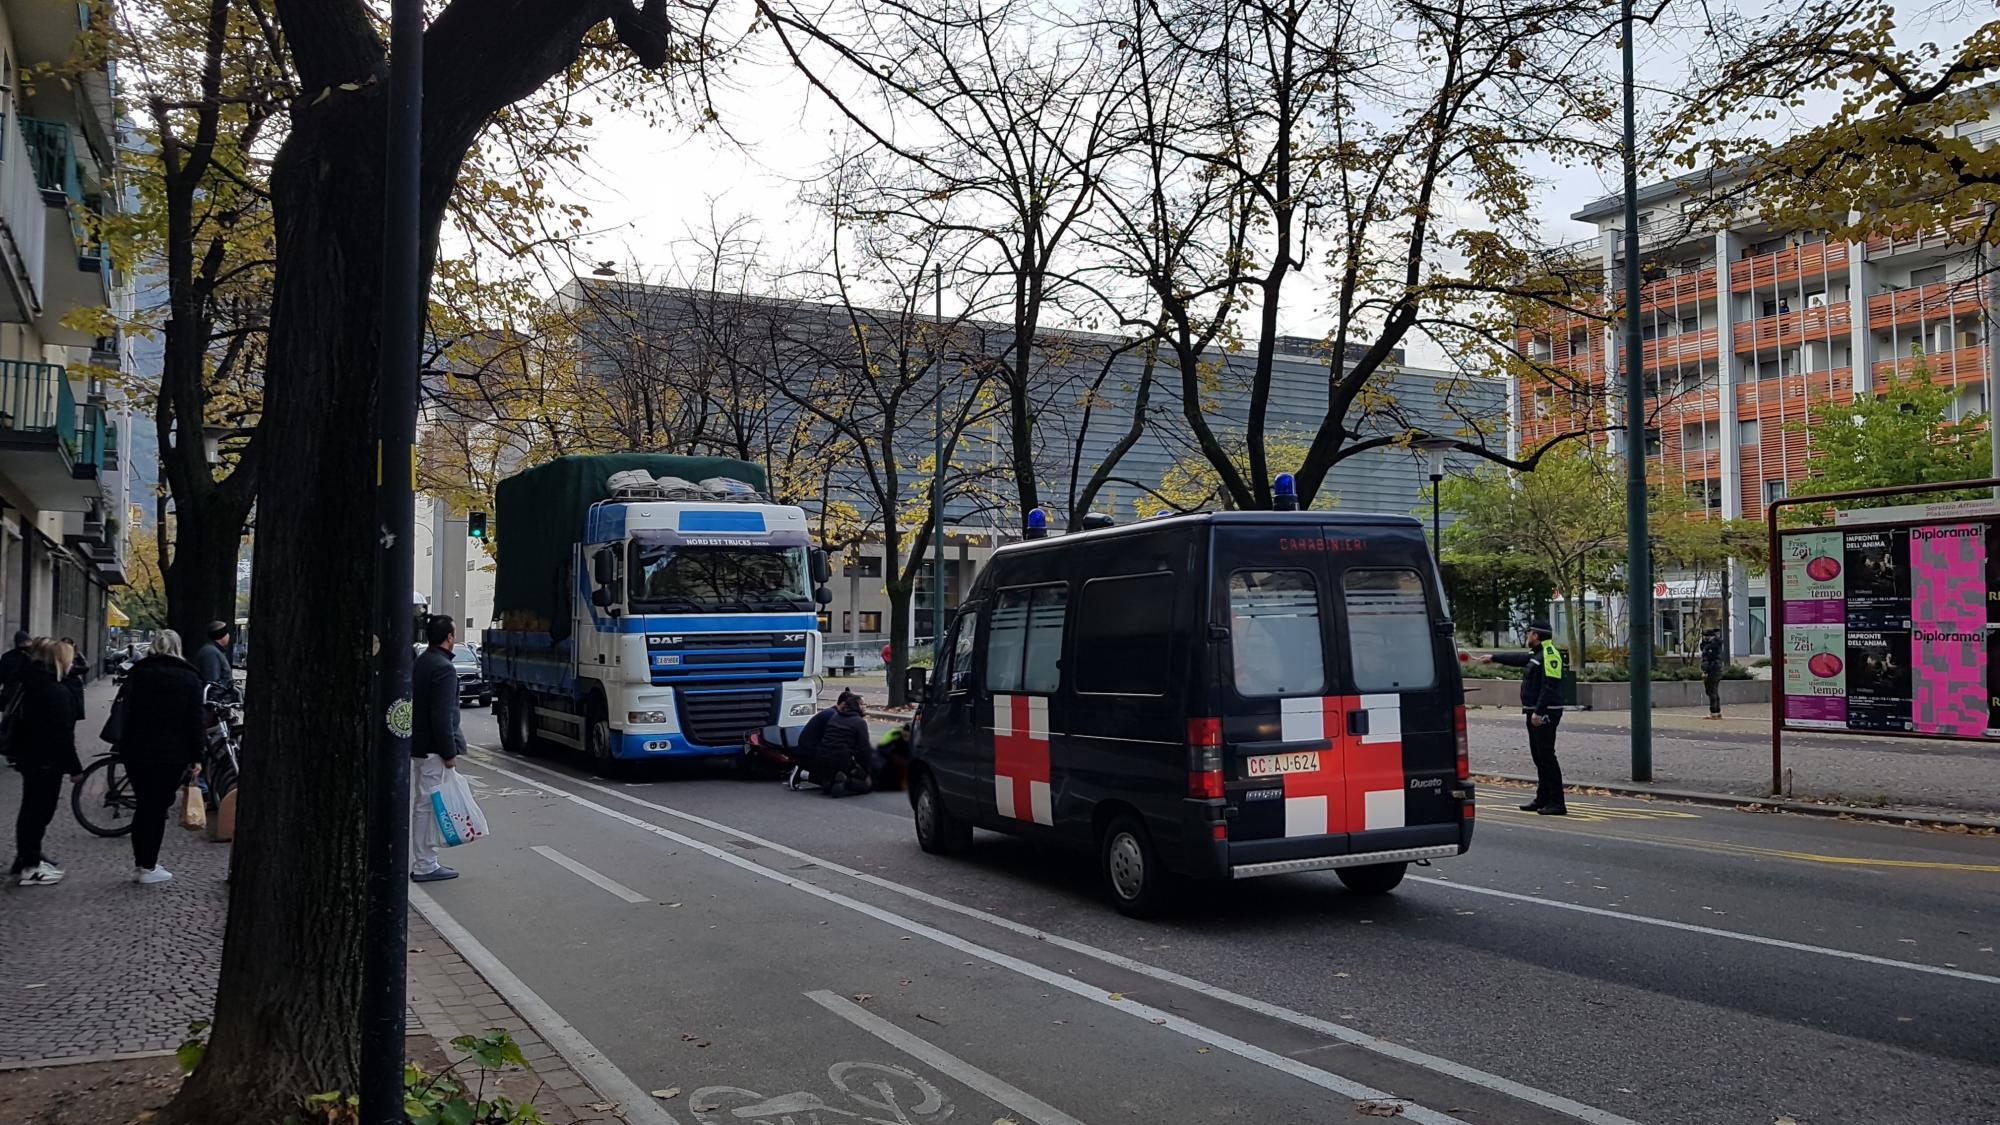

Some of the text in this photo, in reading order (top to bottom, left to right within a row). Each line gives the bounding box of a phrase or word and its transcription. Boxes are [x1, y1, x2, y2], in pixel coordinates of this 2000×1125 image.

[1912, 525, 1982, 542] Diplorama!
[1280, 538, 1367, 551] CARABINIERI
[1846, 541, 1885, 549] DELL'ANIMA
[1811, 590, 1842, 600] tempo
[649, 636, 683, 645] DAF
[1914, 630, 1985, 645] Diplorama!
[1794, 642, 1814, 651] Zeit
[1813, 686, 1844, 696] tempo
[1250, 758, 1266, 774] CC
[1410, 778, 1442, 789] Ducato
